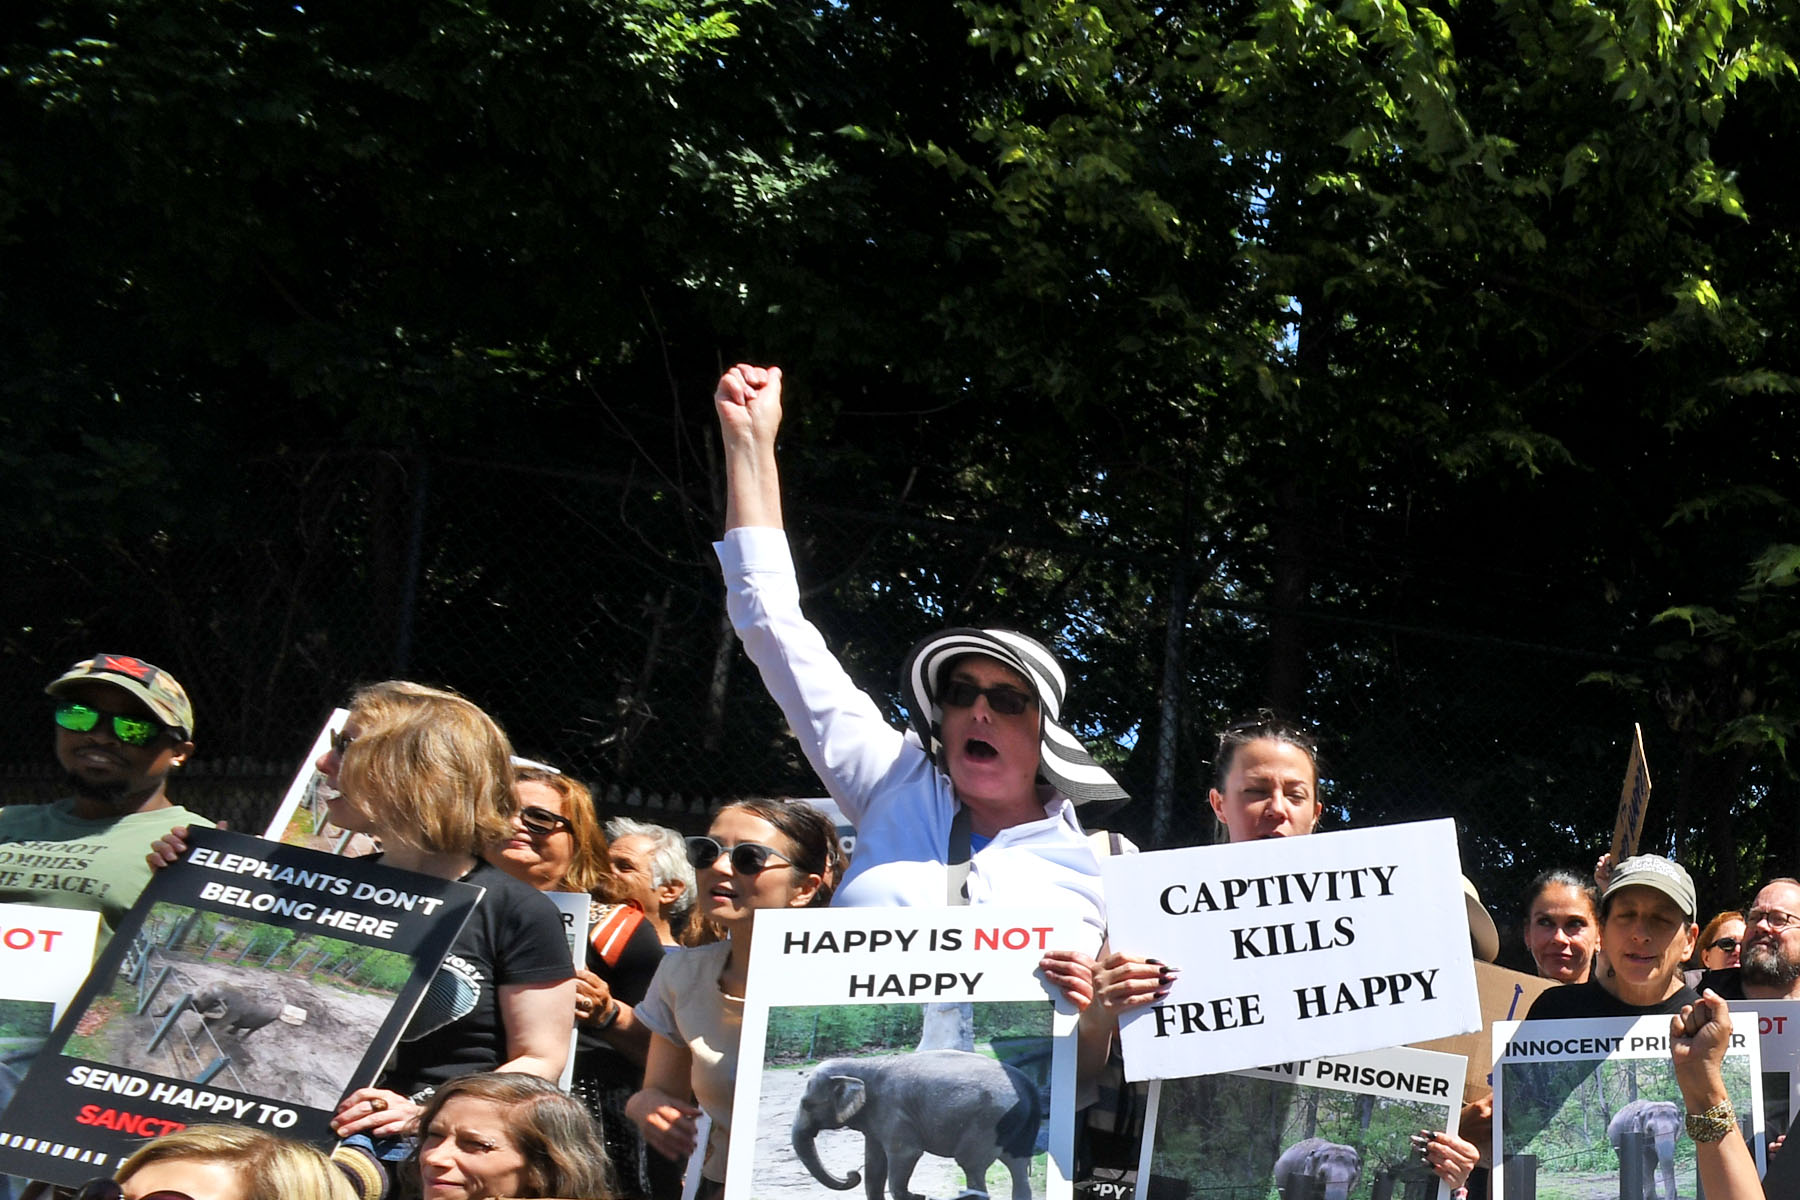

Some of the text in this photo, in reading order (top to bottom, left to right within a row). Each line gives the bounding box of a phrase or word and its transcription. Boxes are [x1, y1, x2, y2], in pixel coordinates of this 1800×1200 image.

[0, 852, 93, 870] OMBIES
[188, 847, 443, 916] ELEPHANTS DON'T
[1159, 865, 1399, 916] CAPTIVITY
[200, 881, 399, 940] BELONG HERE
[0, 927, 63, 953] OT
[783, 926, 1054, 955] HAPPY IS NOT
[1231, 915, 1355, 961] KILLS
[849, 972, 984, 998] HAPPY
[1152, 968, 1440, 1038] FREE HAPPY
[1758, 1016, 1787, 1034] OT
[1505, 1036, 1624, 1057] INNOCENT
[1316, 1059, 1451, 1097] PRISONER
[65, 1065, 297, 1129] SEND HAPPY TO
[76, 1104, 187, 1138] SANCT
[0, 1132, 108, 1166] NONHUMAN
